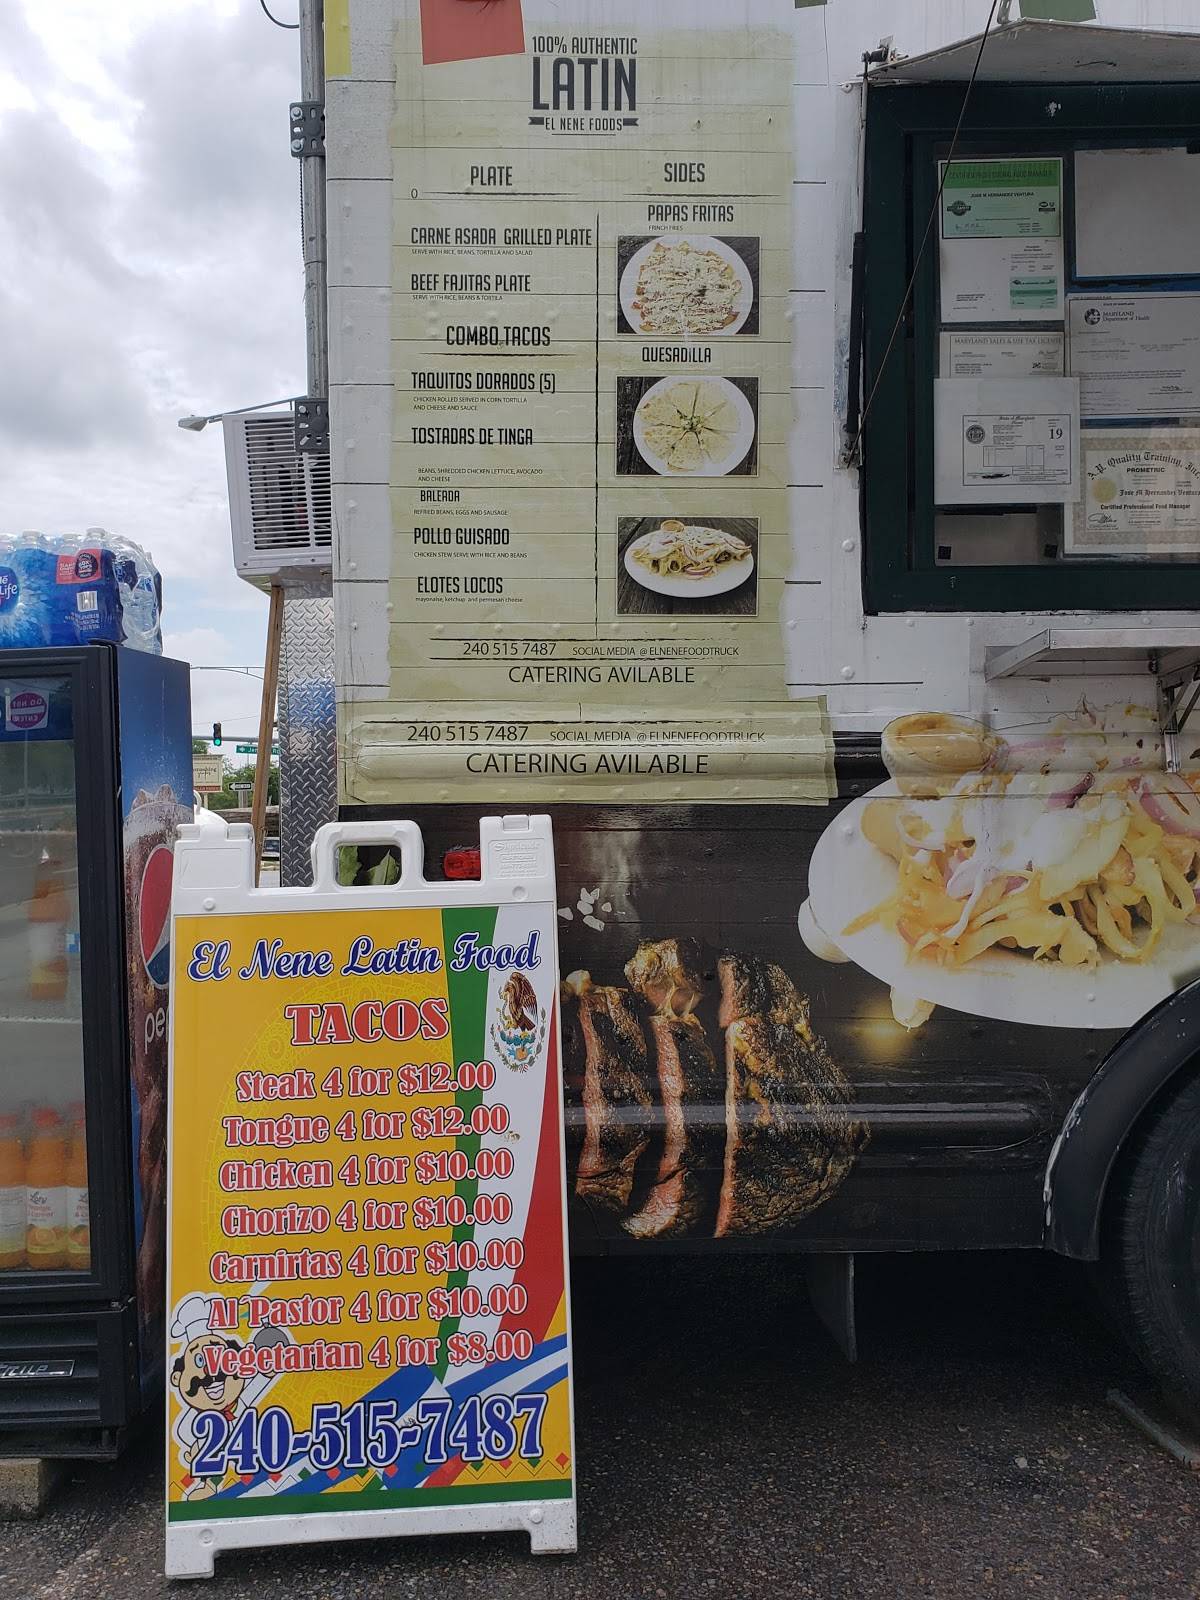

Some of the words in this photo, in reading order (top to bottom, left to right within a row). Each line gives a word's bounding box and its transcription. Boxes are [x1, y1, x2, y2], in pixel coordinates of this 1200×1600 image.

[532, 36, 567, 54] 100%
[571, 36, 638, 54] AUTHENTIC
[532, 57, 636, 111] LATIN
[545, 118, 556, 131] EL
[560, 118, 585, 131] NENE
[589, 118, 623, 131] FOODS
[470, 165, 513, 186] PLATE
[664, 162, 706, 183] SIDES
[648, 205, 688, 222] PAPAS
[692, 205, 734, 222] FRITAS
[411, 227, 451, 244] CARNE
[455, 228, 496, 244] ASADA
[504, 228, 551, 245] GRILLED
[556, 229, 592, 245] PLATE
[411, 274, 439, 291] BEEF
[444, 274, 490, 291] FAJITAS
[495, 274, 531, 291] PLATE
[446, 326, 499, 346] COMBO
[504, 326, 551, 346] TACOS
[642, 347, 711, 363] QUESADILLA
[412, 372, 472, 389] TAQUITOS
[476, 373, 535, 390] DORADOS
[412, 428, 475, 445] TOSTADAS
[479, 428, 493, 445] DE
[498, 428, 533, 445] TINGA
[1049, 428, 1063, 440] 19
[420, 490, 460, 502] BALEADA
[414, 528, 451, 545] POLLO
[456, 528, 510, 545] GUISADO
[418, 576, 460, 593] ELOTES
[464, 576, 503, 593] LOCOS
[463, 643, 489, 656] 240
[492, 643, 518, 656] 515
[522, 643, 557, 656] 7487
[573, 647, 605, 656] SOCIAL
[607, 647, 636, 656] MEDIA
[650, 647, 739, 656] ELNENEFOODTRUCK
[508, 666, 601, 683] CATERING
[608, 666, 695, 683] AVILABLE
[407, 725, 441, 741] 240
[446, 725, 479, 741] 515
[484, 725, 529, 741] 7487
[550, 731, 591, 742] SOCIAL
[593, 731, 632, 741] MEDIA
[466, 753, 587, 774] CATERING
[594, 753, 709, 774] AVILABLE
[188, 939, 231, 982] El
[238, 937, 335, 982] Nene
[341, 934, 443, 977] Latin
[449, 930, 542, 972] Food
[285, 998, 450, 1046] TACOS
[236, 1069, 316, 1102] Steak
[321, 1067, 342, 1098] 4
[348, 1065, 393, 1096] for
[398, 1060, 496, 1095] $12.00
[222, 1113, 331, 1148] Tongue
[335, 1110, 356, 1142] 4
[361, 1110, 406, 1140] for
[411, 1103, 510, 1140] $12.00
[219, 1157, 333, 1193] Chicken
[338, 1154, 360, 1187] 4
[365, 1153, 410, 1186] for
[414, 1148, 514, 1184] $10.00
[221, 1203, 331, 1238] Chorizo
[336, 1201, 358, 1232] 4
[363, 1199, 408, 1230] for
[413, 1193, 513, 1230] $10.00
[347, 1245, 369, 1277] 4
[374, 1244, 420, 1275] for
[424, 1238, 526, 1274] $10.00
[207, 1297, 238, 1330] Al
[349, 1291, 371, 1323] 4
[377, 1290, 421, 1321] for
[427, 1283, 528, 1319] $10.00
[202, 1339, 363, 1377] Vegetarian
[368, 1337, 391, 1368] 4
[396, 1335, 440, 1367] for
[446, 1330, 535, 1366] $8.00
[190, 1392, 548, 1477] 240-515-7487
